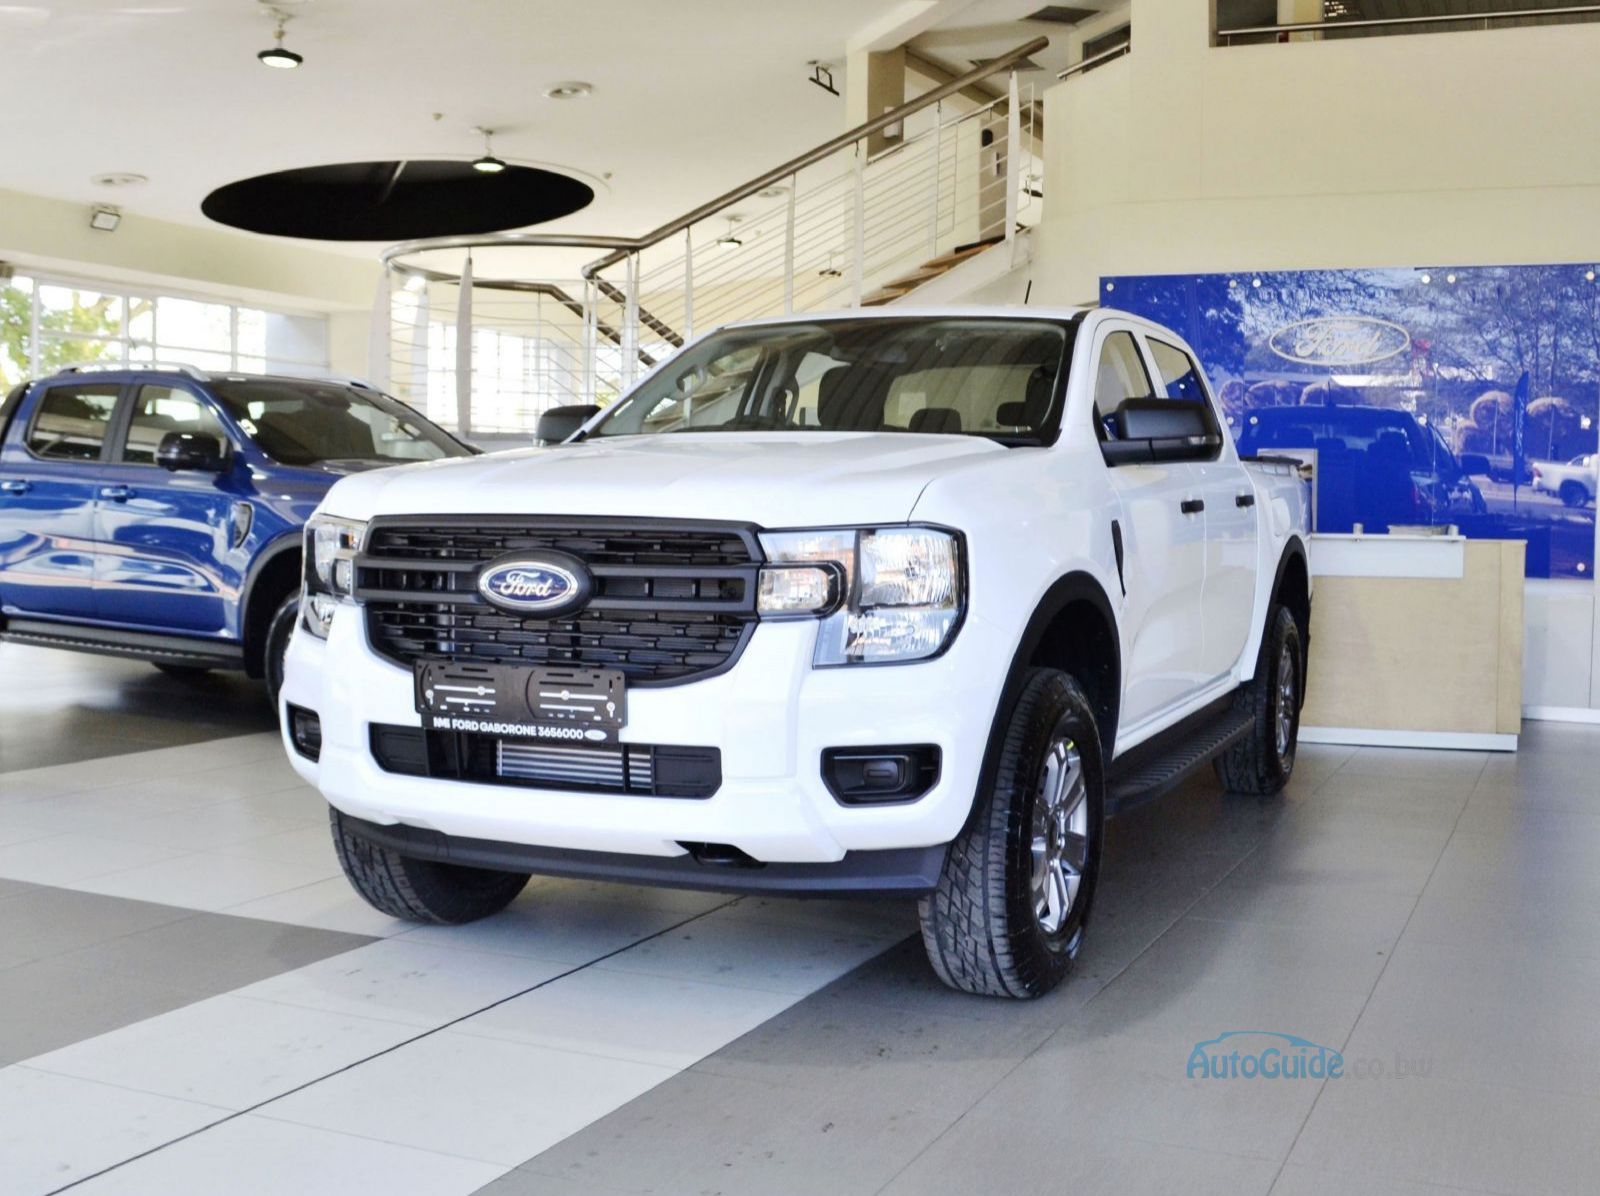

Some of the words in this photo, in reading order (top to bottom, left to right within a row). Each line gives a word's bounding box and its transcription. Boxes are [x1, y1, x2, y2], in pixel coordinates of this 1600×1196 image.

[1295, 322, 1382, 357] Ford
[498, 570, 553, 596] Ford
[452, 719, 479, 731] FORD
[480, 722, 537, 736] GABORONE
[538, 725, 583, 740] 3656000
